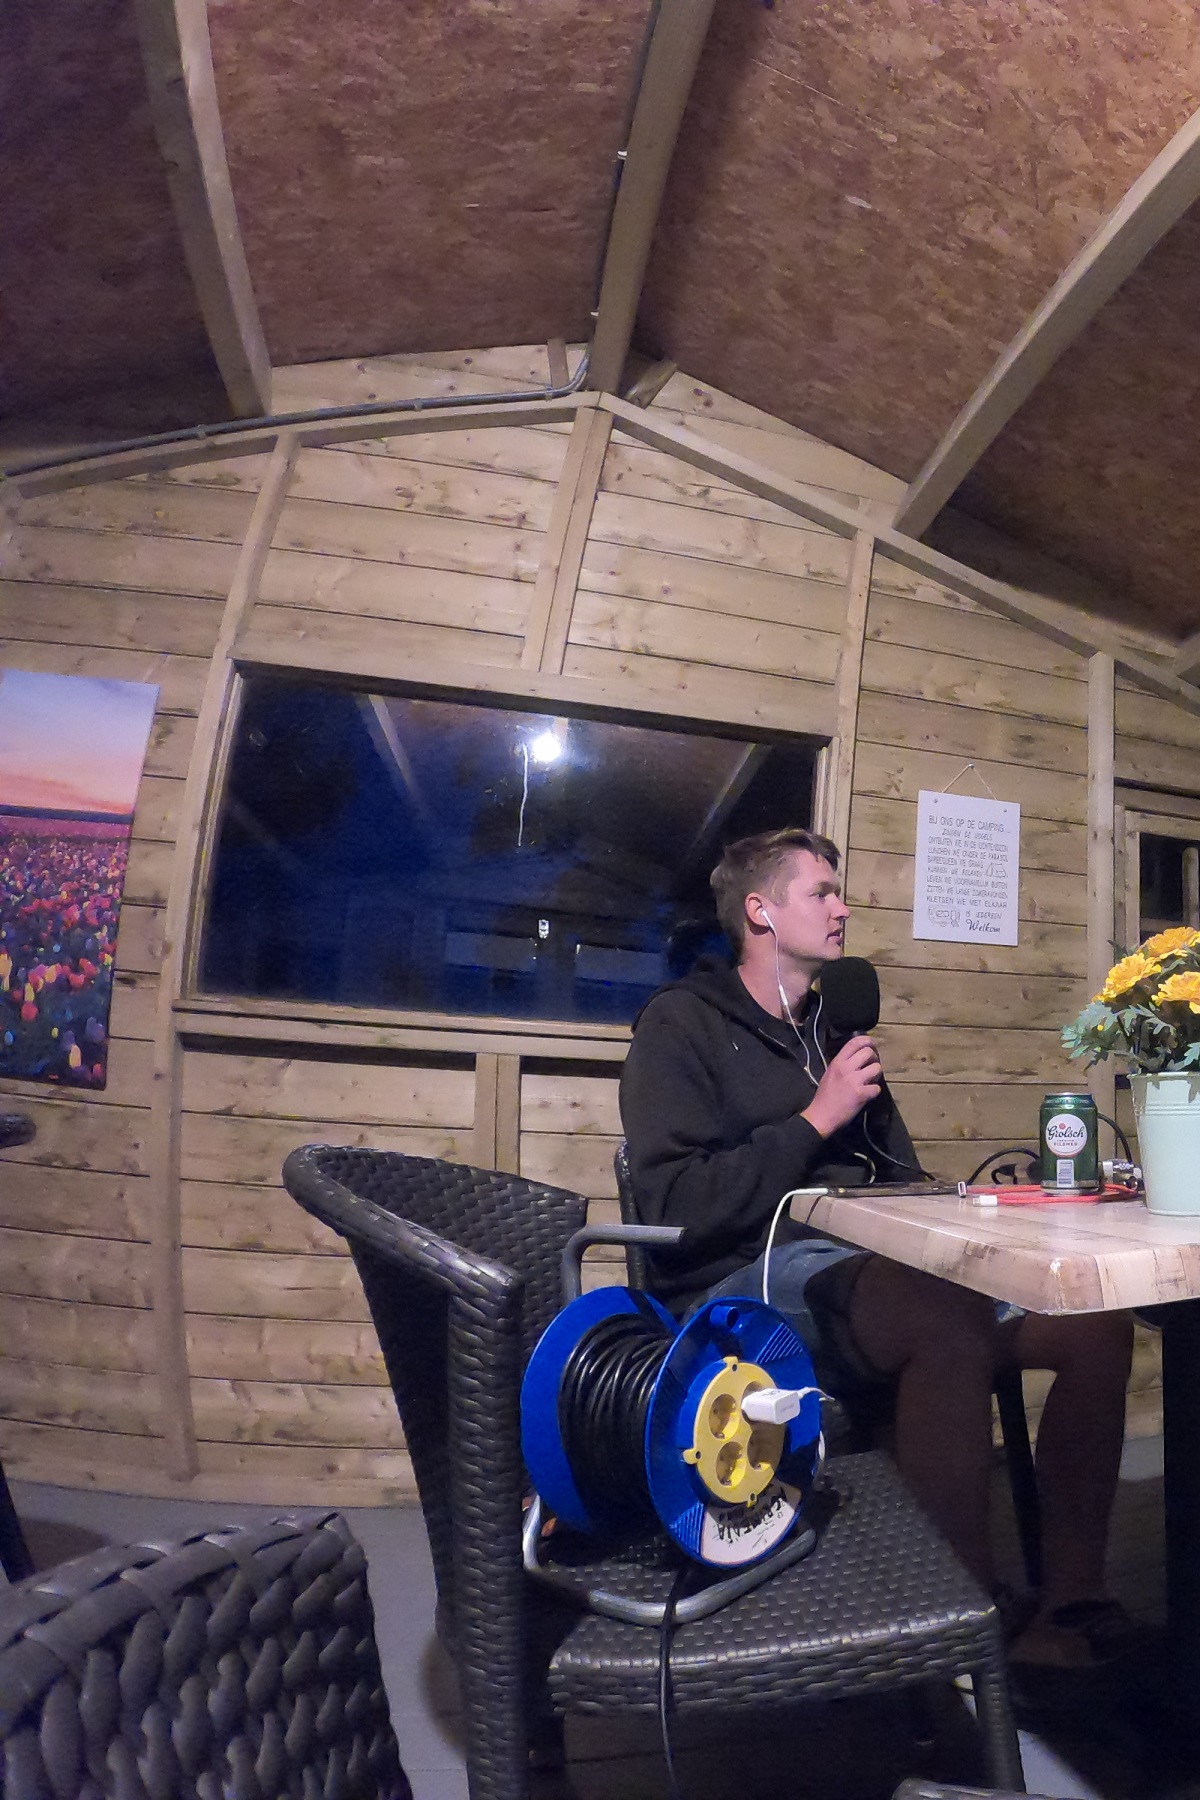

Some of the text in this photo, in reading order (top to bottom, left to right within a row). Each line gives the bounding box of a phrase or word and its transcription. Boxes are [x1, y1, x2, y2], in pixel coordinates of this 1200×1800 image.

[940, 816, 953, 826] ONS
[956, 818, 964, 828] OP
[967, 819, 976, 830] DE
[926, 874, 942, 883] LEVEN
[944, 876, 952, 884] WE
[926, 895, 954, 904] KLETSEN
[956, 898, 966, 906] WE
[984, 900, 1008, 908] ELKAAR
[966, 918, 1000, 932] Welkom
[1048, 1126, 1084, 1140] Grolsch
